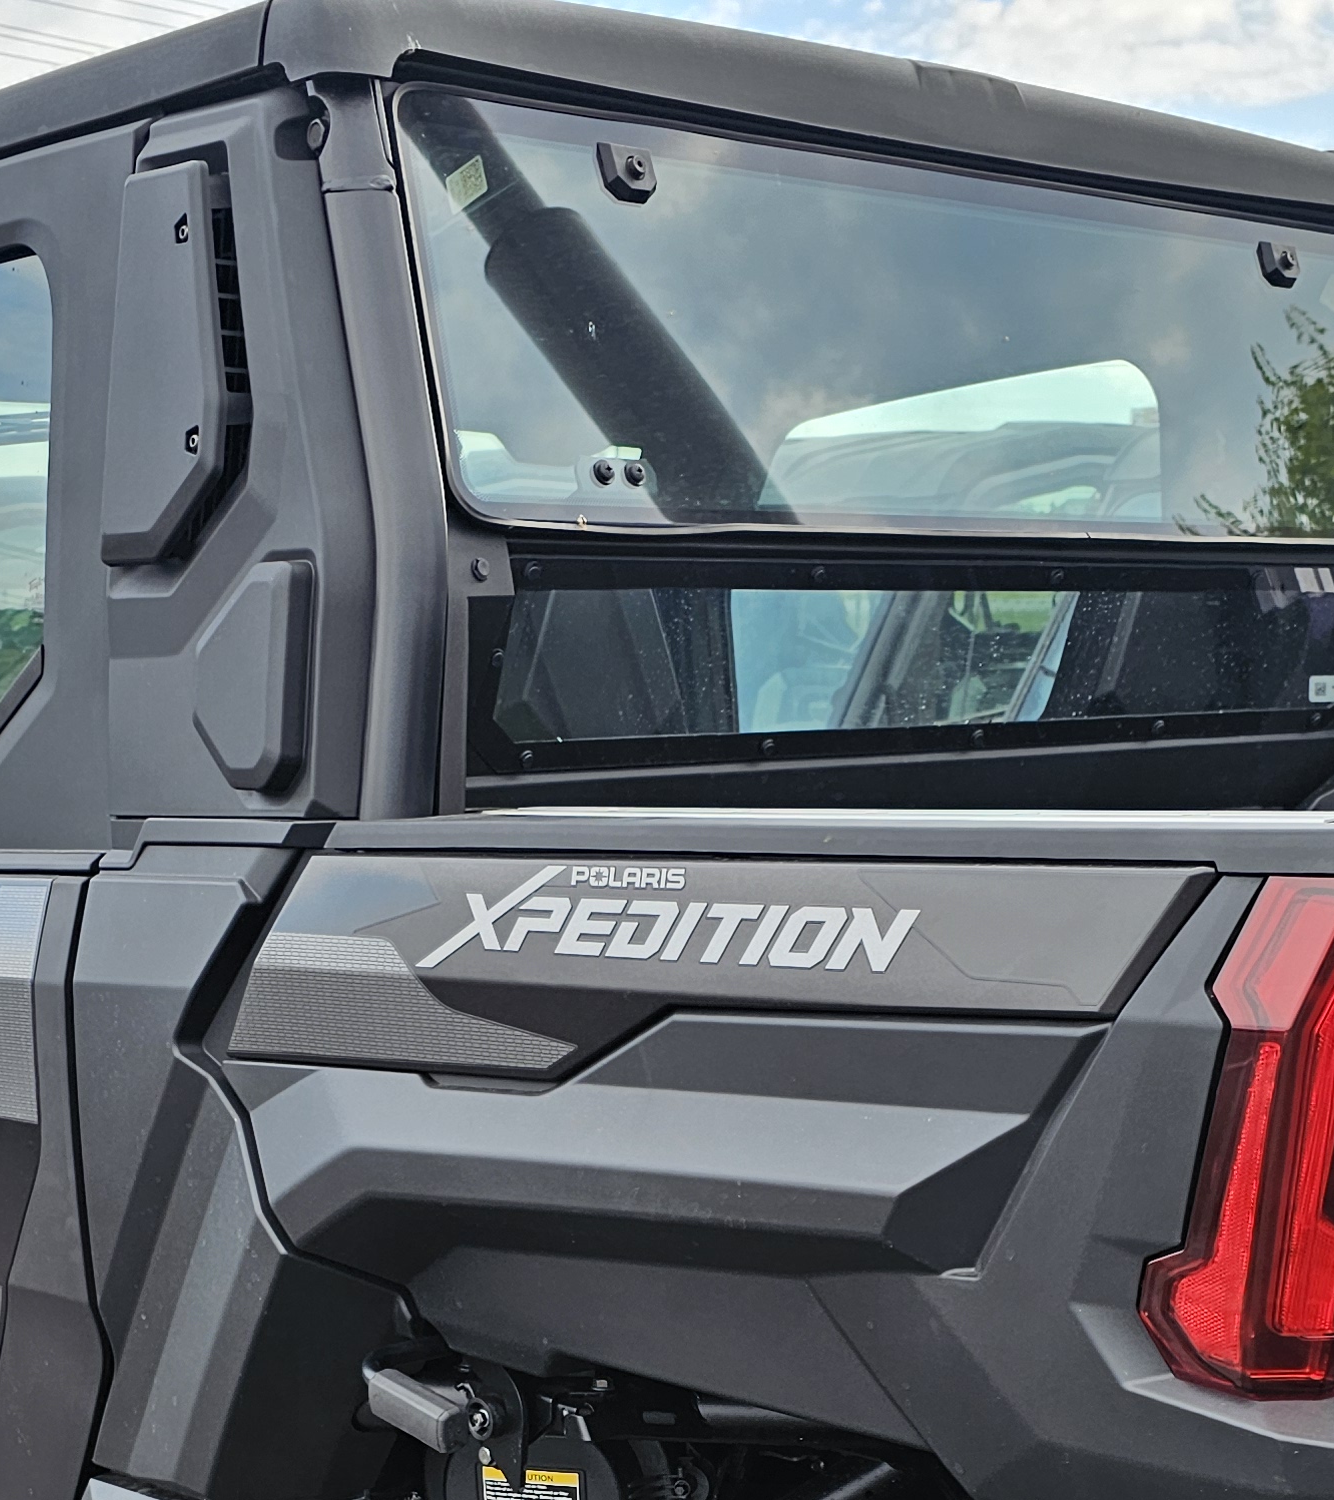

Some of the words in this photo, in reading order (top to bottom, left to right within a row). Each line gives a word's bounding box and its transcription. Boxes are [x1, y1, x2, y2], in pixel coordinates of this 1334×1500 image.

[570, 866, 686, 890] POLARIS
[415, 865, 921, 973] XPEDITION
[527, 1474, 554, 1482] UTION
